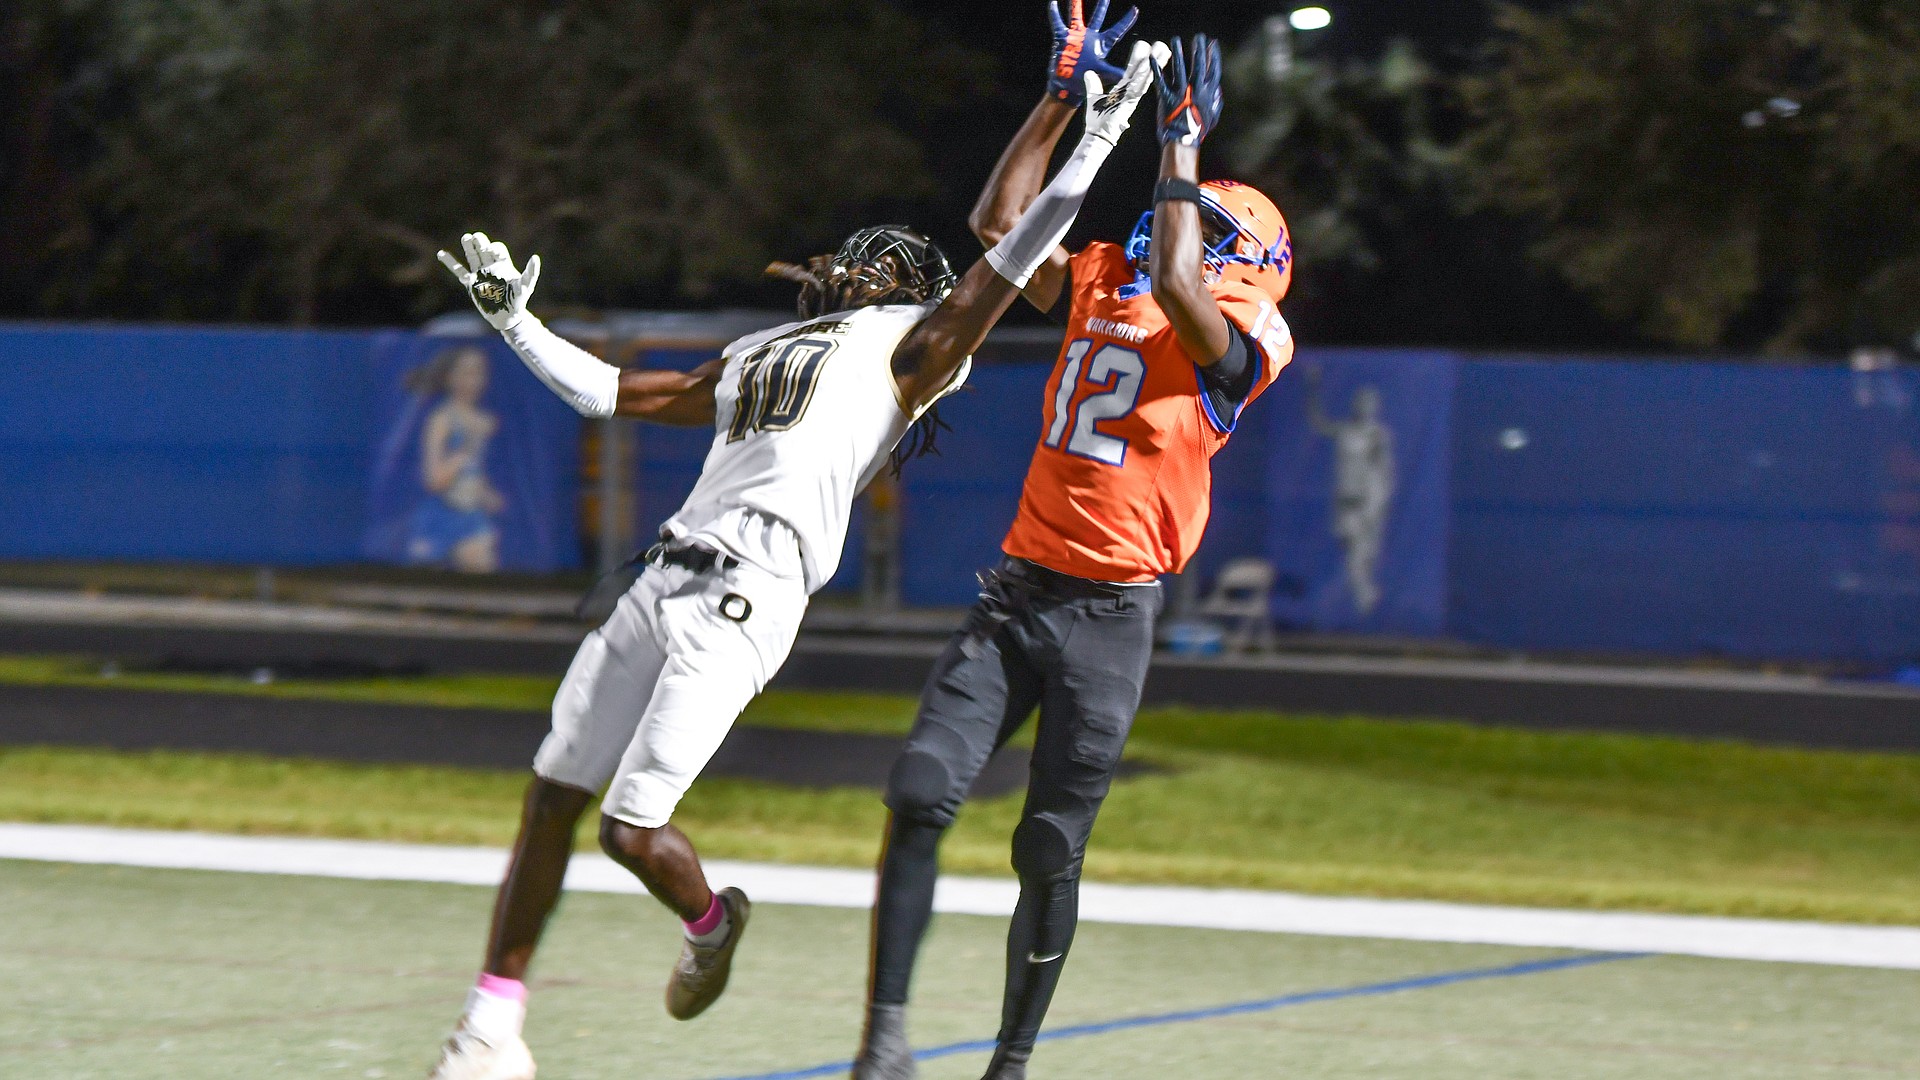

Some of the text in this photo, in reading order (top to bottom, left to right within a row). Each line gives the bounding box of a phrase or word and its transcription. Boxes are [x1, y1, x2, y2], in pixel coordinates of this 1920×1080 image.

[474, 281, 506, 303] UCF
[1086, 316, 1149, 344] WARRIORS
[1249, 300, 1291, 363] 12
[726, 338, 840, 445] 10
[1044, 337, 1148, 468] 12
